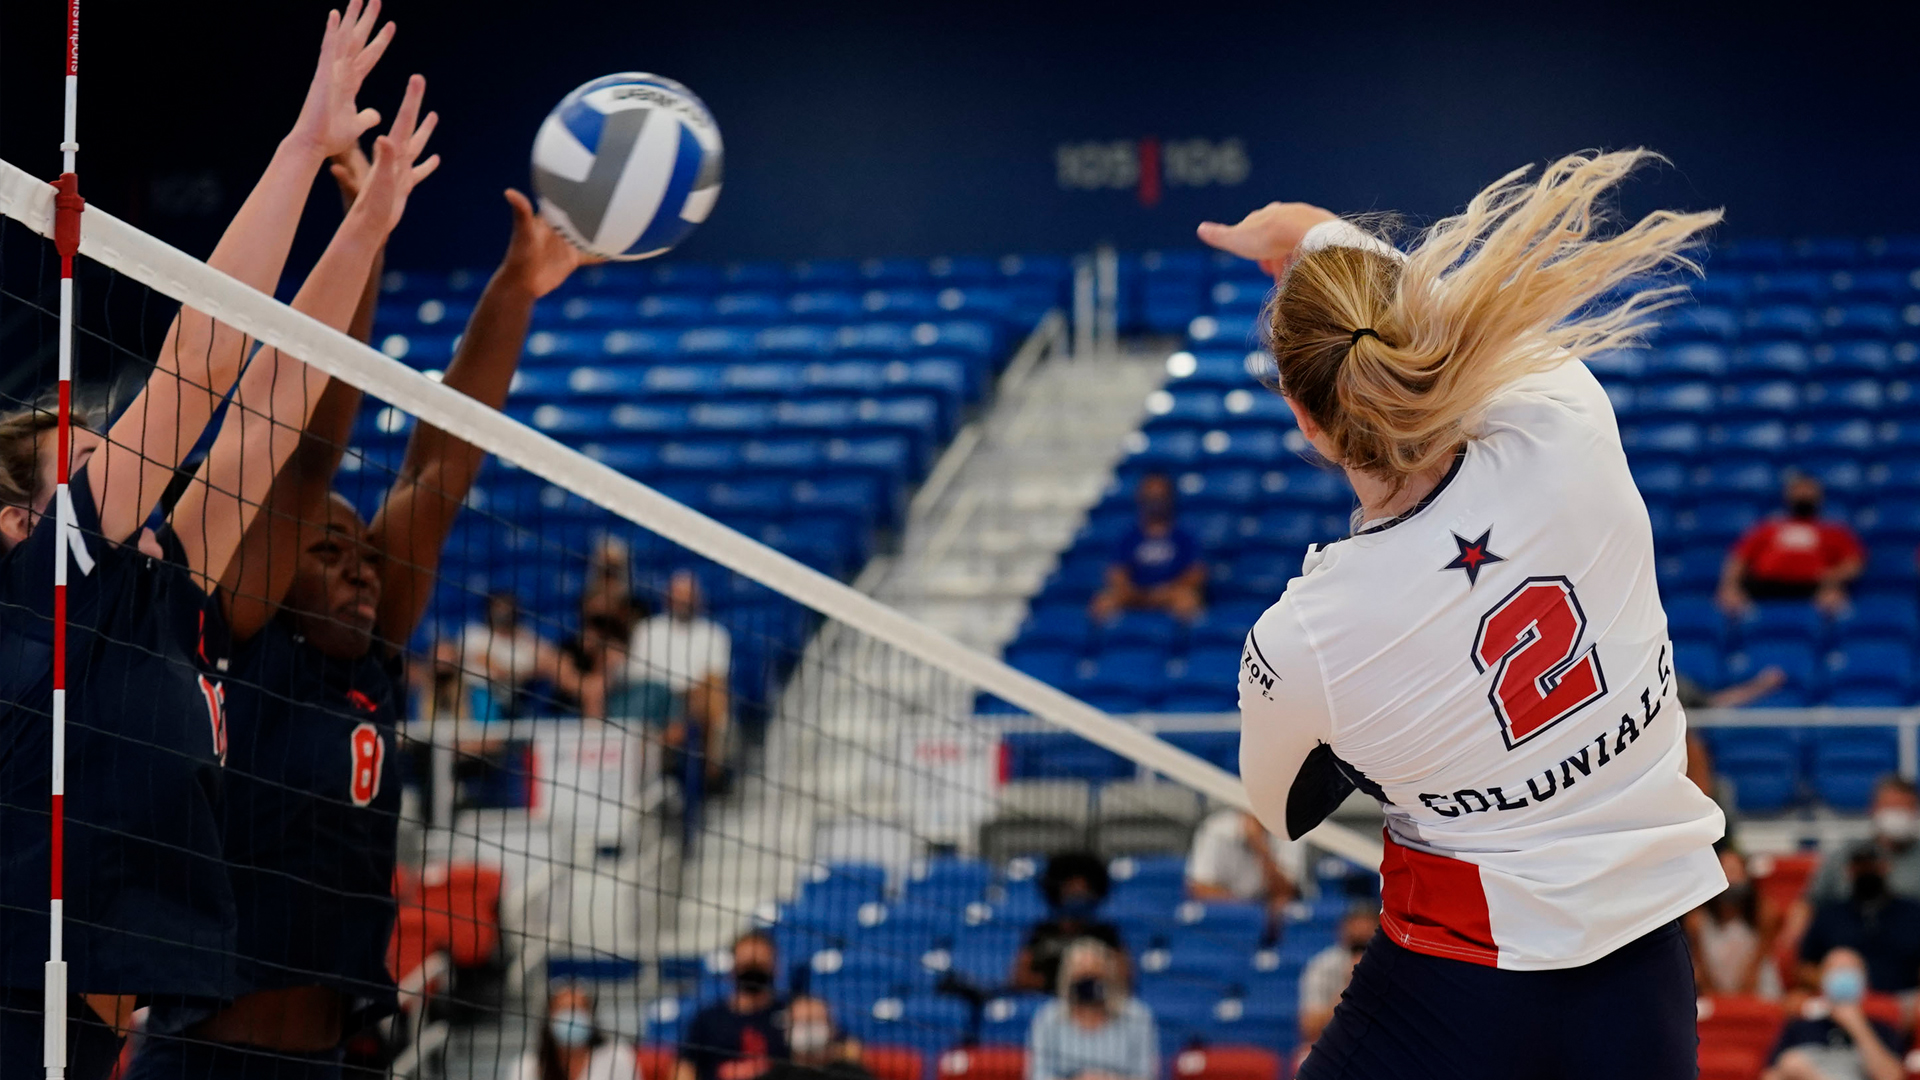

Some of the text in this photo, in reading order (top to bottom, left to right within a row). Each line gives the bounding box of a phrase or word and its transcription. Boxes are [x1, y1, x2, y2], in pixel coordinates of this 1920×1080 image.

[1057, 138, 1250, 189] 105 106
[1243, 644, 1275, 690] ZON
[1470, 575, 1608, 751] 2
[351, 722, 384, 807] 8
[1418, 645, 1670, 817] COLONIALS
